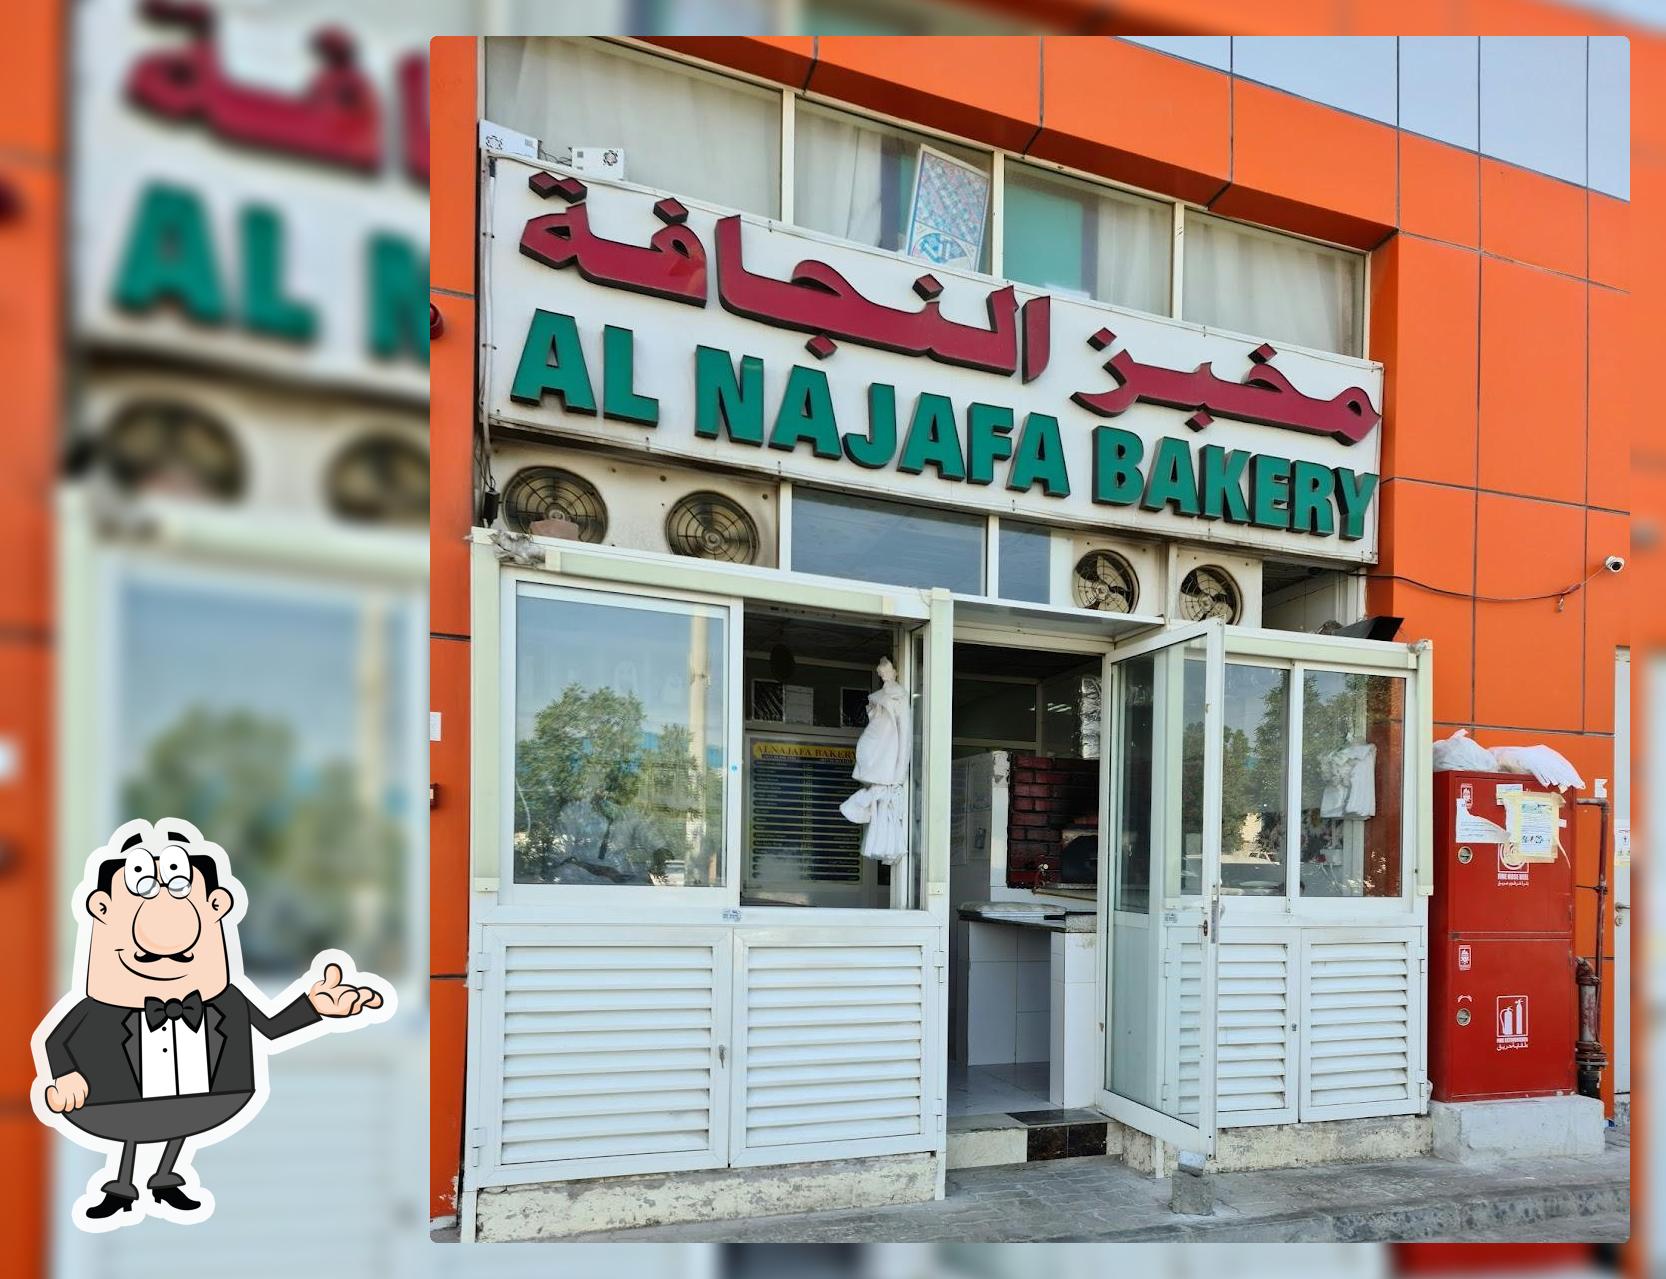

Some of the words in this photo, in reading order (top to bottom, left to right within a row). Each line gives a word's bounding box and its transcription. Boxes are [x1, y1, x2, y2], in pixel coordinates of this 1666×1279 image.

[519, 171, 1051, 385] النجافة
[510, 308, 660, 427] AL
[694, 344, 1071, 498] NAJAFA
[1092, 425, 1380, 541] BAKERY
[1071, 327, 1383, 446] مخبز
